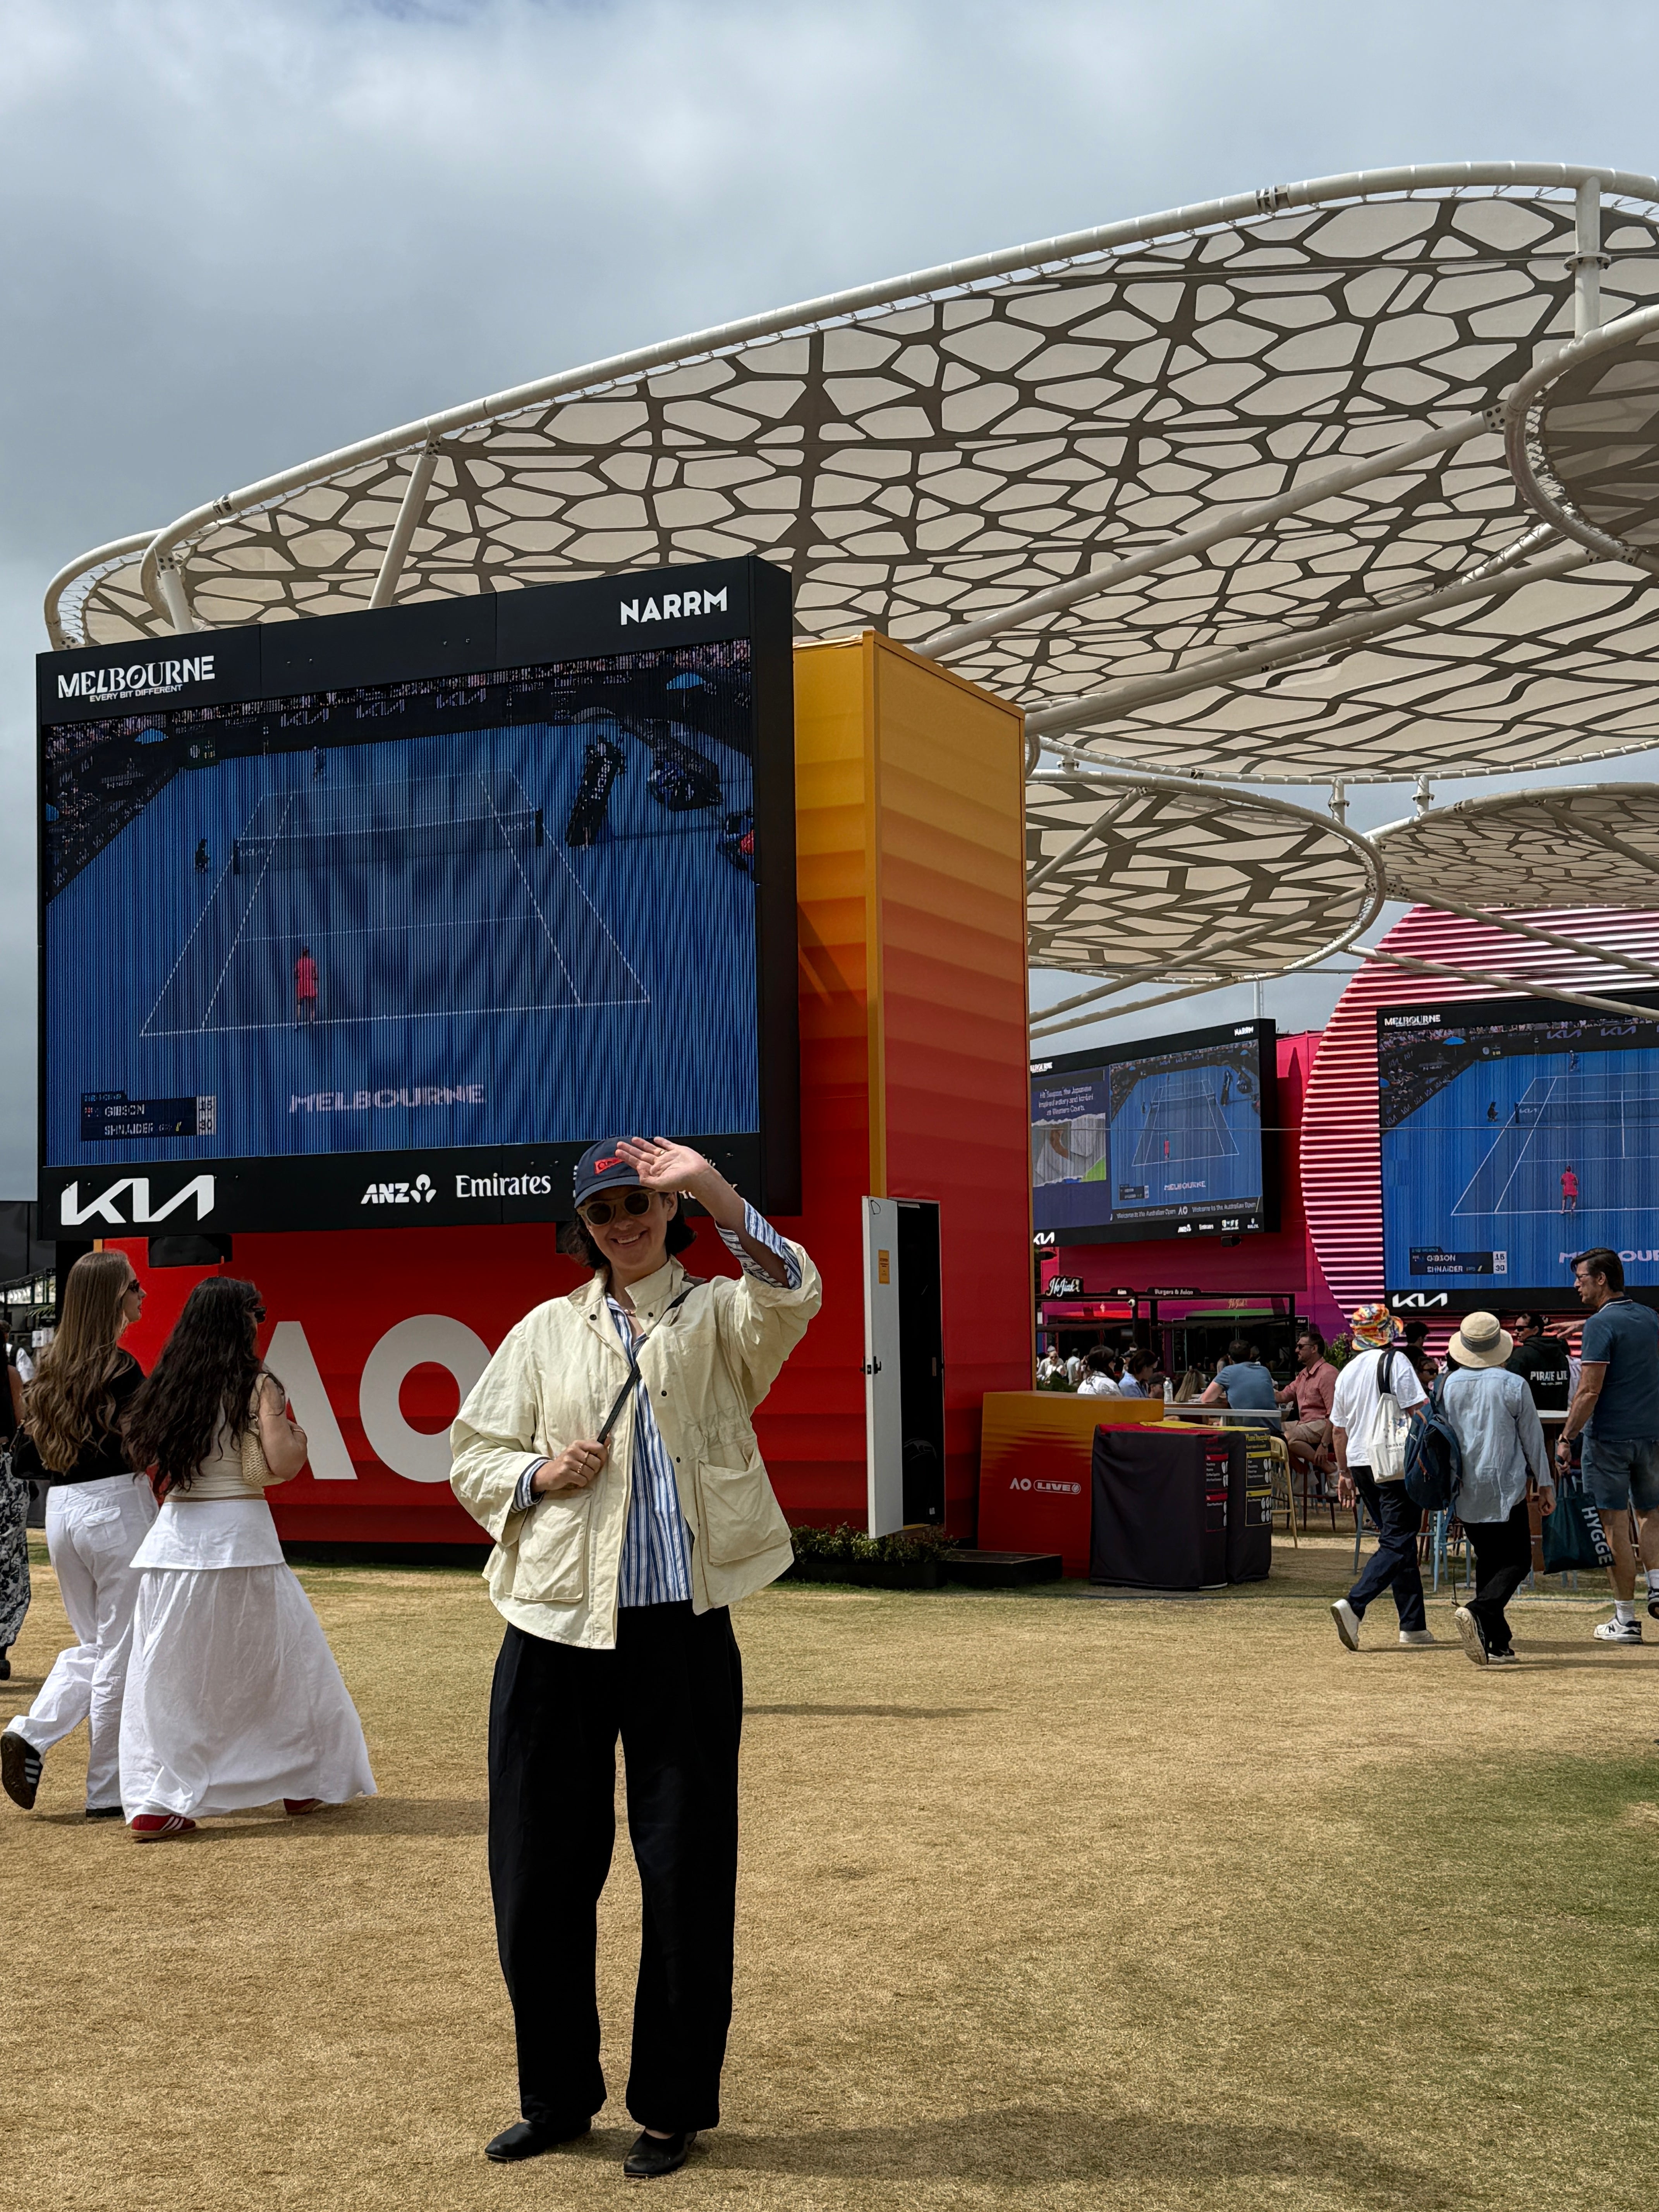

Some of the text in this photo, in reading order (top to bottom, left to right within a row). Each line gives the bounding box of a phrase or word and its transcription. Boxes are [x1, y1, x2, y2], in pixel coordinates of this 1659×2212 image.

[620, 586, 727, 626] NARRM
[58, 655, 215, 699] MELBOURNE
[89, 684, 183, 702] EVERY BIT DIFFERENT
[1384, 1015, 1441, 1026] MELBOURNE
[105, 1104, 145, 1117] GIBSON
[290, 1084, 486, 1113] MELBOURNE
[361, 1182, 409, 1204] ANZ
[455, 1172, 551, 1198] Emirates
[61, 1175, 214, 1226] KIA
[1392, 1293, 1448, 1307] KIA
[262, 1314, 492, 1483] AO
[1009, 1477, 1071, 1491] AO LIVE
[1582, 1506, 1613, 1565] HYGGE
